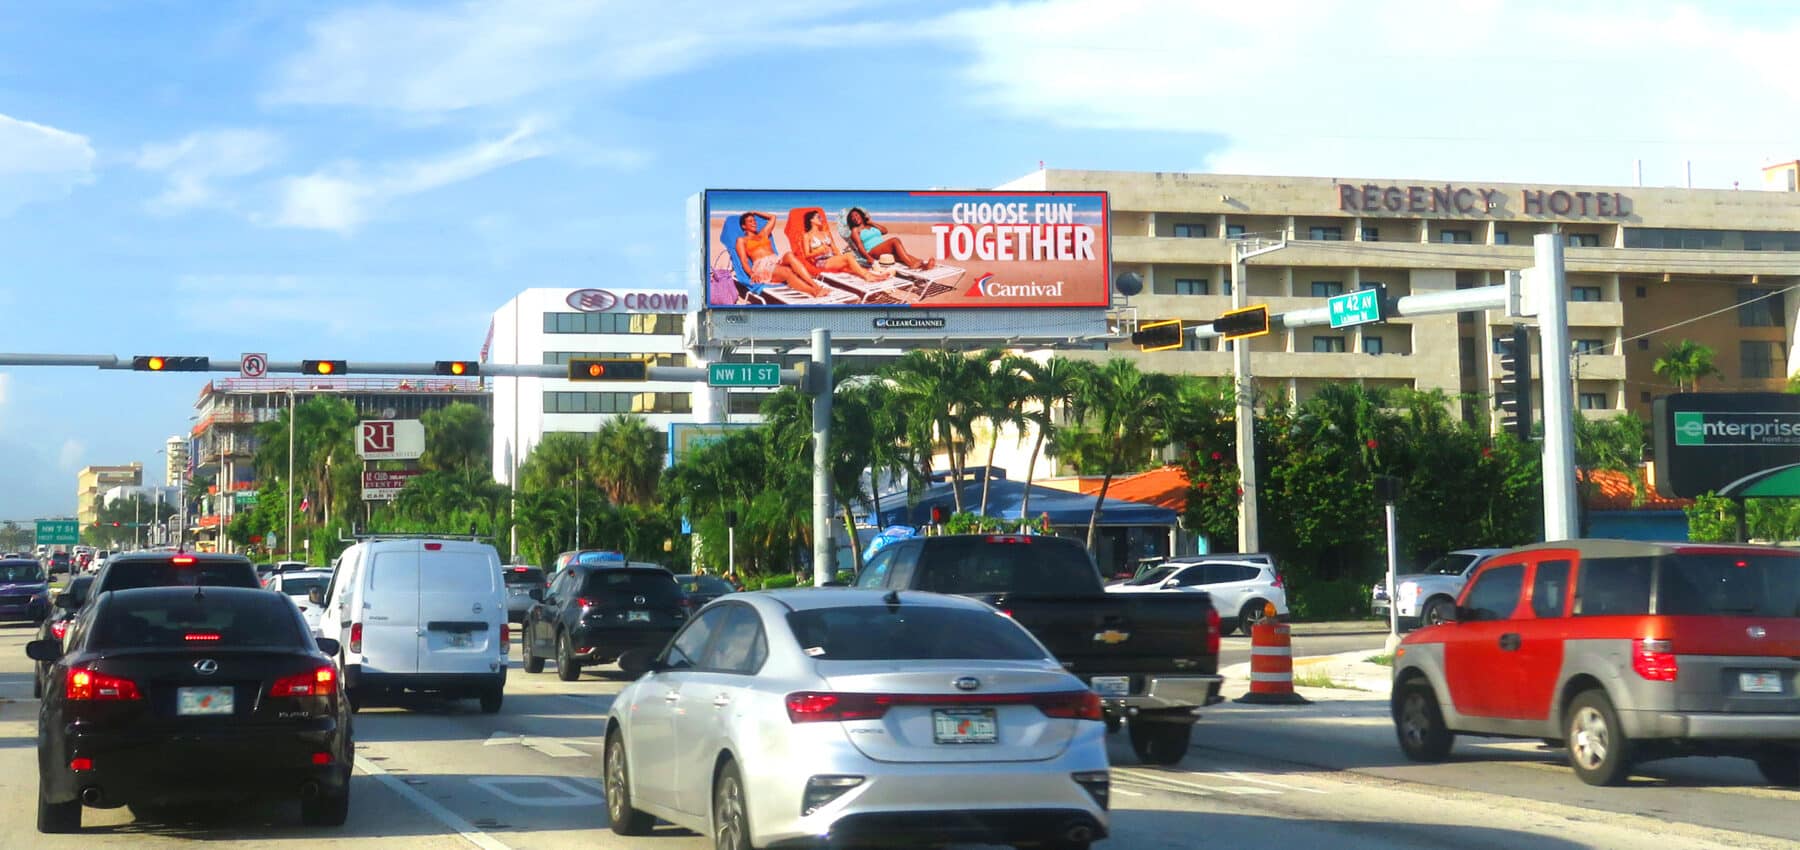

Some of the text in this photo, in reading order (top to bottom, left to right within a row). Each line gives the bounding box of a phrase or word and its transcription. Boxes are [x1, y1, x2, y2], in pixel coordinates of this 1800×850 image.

[1336, 183, 1630, 217] REGENCY HOTEL
[952, 202, 1073, 224] CHOOSE FUN
[931, 225, 1096, 261] TOGETHER
[987, 281, 1064, 297] Carnival
[1333, 295, 1372, 314] NW 42 AV
[715, 367, 773, 380] NW 11 ST
[1683, 419, 1800, 440] enterprise
